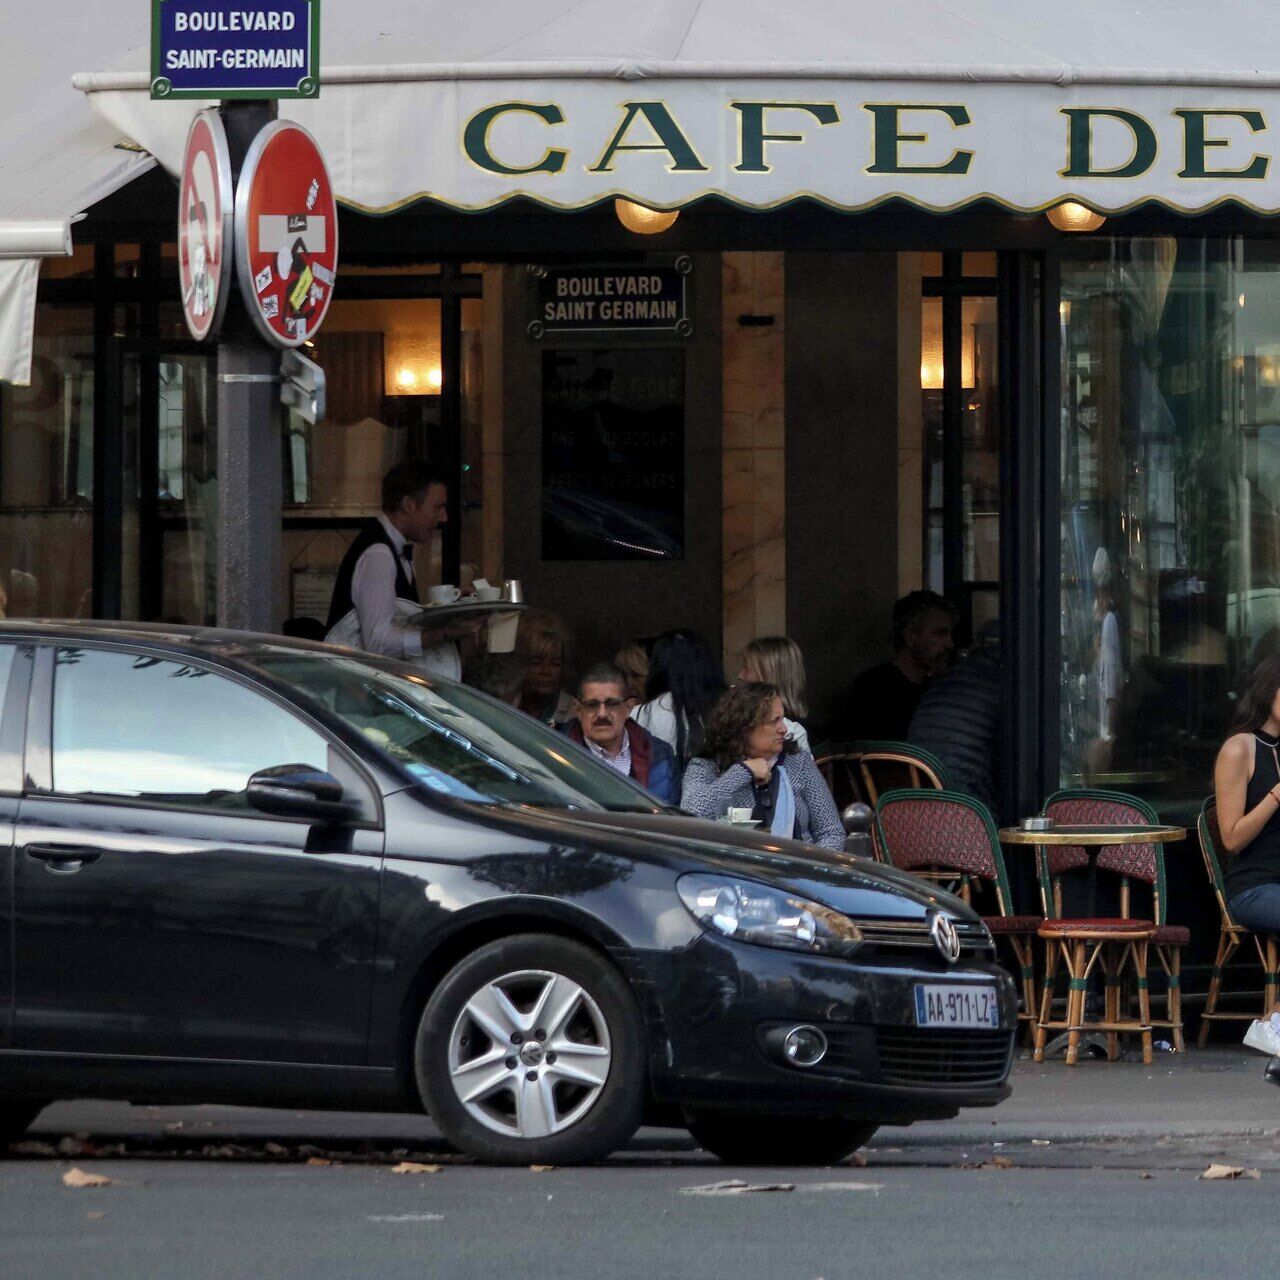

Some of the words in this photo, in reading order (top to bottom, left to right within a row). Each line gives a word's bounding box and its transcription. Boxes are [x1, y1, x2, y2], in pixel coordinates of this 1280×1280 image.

[174, 10, 296, 33] BOULEVARD
[165, 48, 305, 71] SAINT-GERMAIN
[460, 99, 974, 179] CAFE
[1058, 106, 1273, 182] DE
[556, 275, 663, 297] BOULEVARD
[544, 301, 596, 322] SAINT
[600, 300, 677, 321] GERMAIN
[928, 992, 990, 1023] AA-971-LZ
